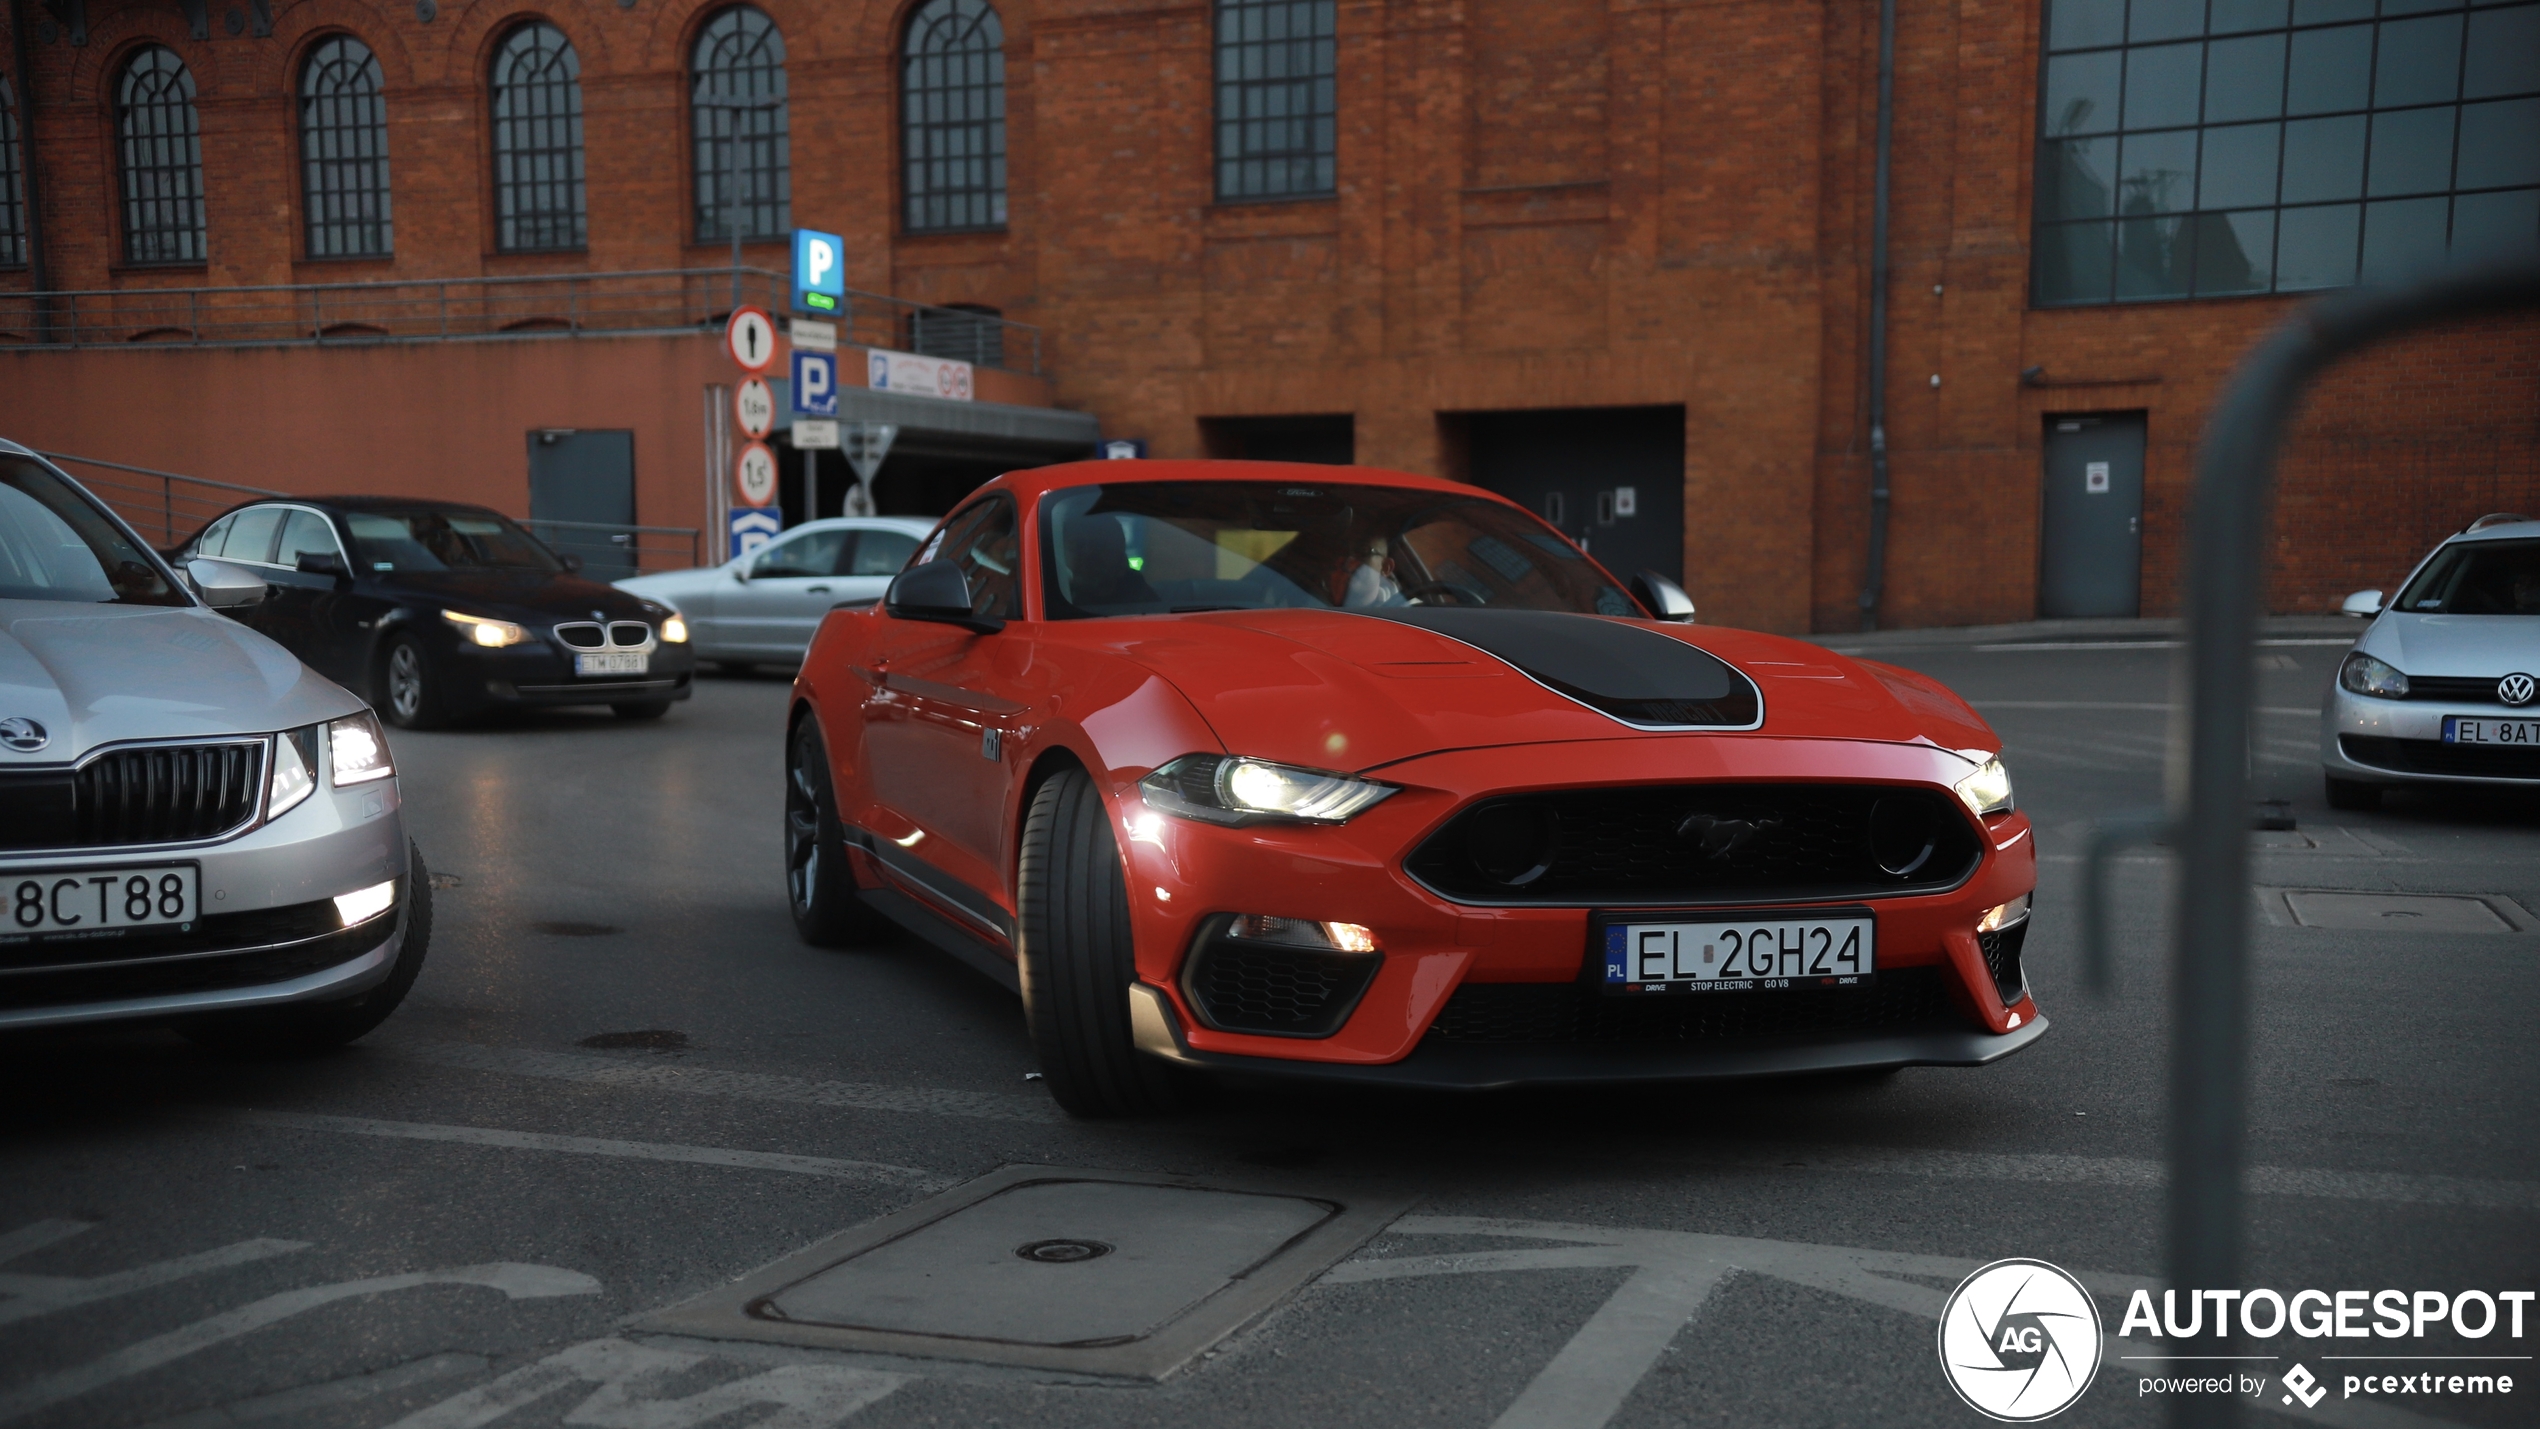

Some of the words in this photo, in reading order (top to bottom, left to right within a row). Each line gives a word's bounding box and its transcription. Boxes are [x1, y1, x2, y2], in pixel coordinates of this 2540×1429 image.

[809, 238, 833, 287] P
[801, 356, 829, 408] P
[2460, 721, 2488, 742] EL
[2500, 723, 2540, 743] 8AT
[14, 873, 184, 927] 8CT88
[1607, 964, 1624, 978] PL
[1638, 930, 1697, 981] EL
[1718, 925, 1860, 977] 2GH24
[1691, 981, 1713, 991] STOP
[1714, 980, 1754, 990] ELECTRIC
[1764, 979, 1777, 989] GO
[1778, 978, 1789, 988] V8
